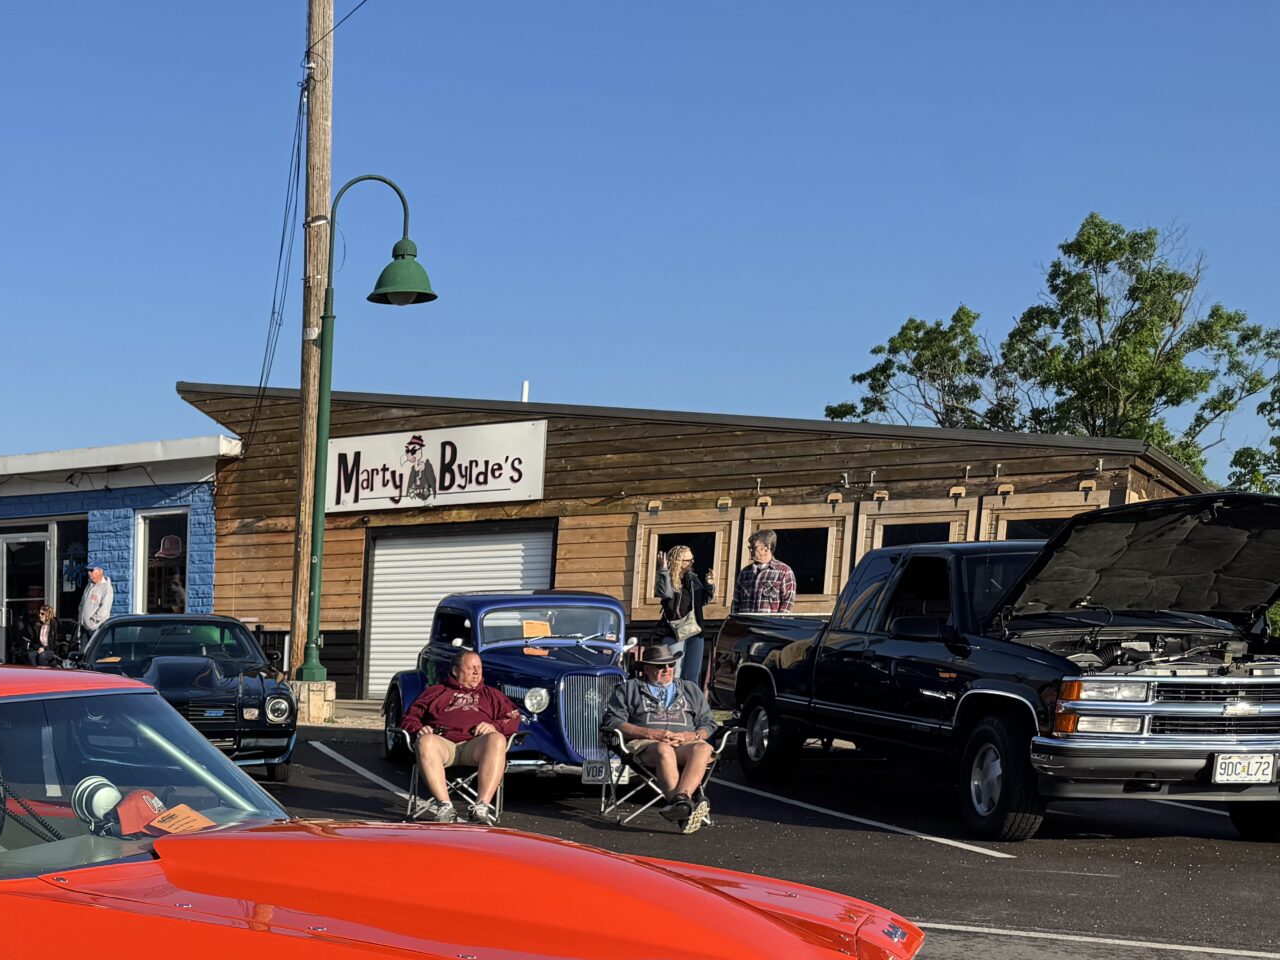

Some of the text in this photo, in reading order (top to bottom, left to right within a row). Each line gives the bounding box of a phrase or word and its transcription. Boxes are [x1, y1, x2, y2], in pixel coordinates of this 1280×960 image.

[335, 440, 523, 505] Marty Byrde's
[1219, 761, 1270, 777] 9DC L72
